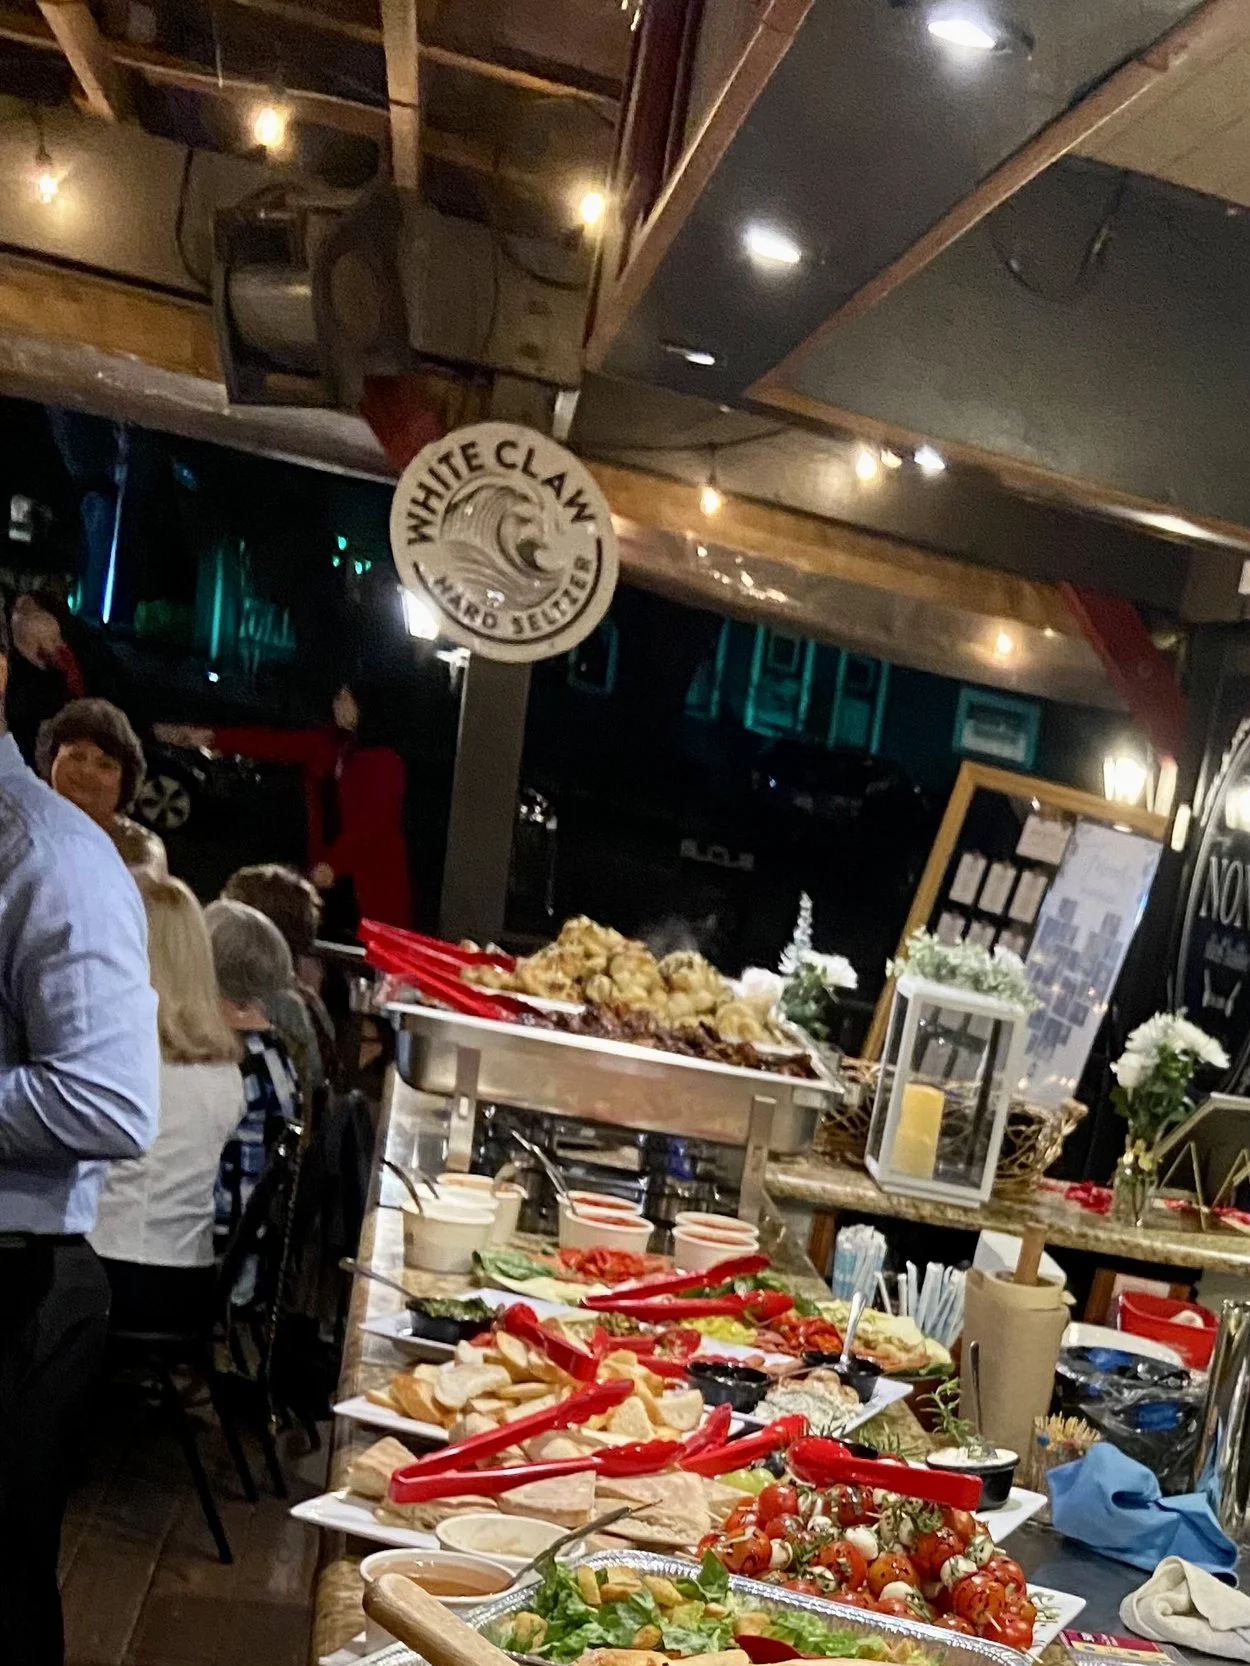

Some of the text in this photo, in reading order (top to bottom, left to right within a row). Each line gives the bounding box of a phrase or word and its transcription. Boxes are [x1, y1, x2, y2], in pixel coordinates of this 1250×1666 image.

[407, 440, 596, 546] WHITE CLAW
[434, 556, 592, 634] HARD SELTZER
